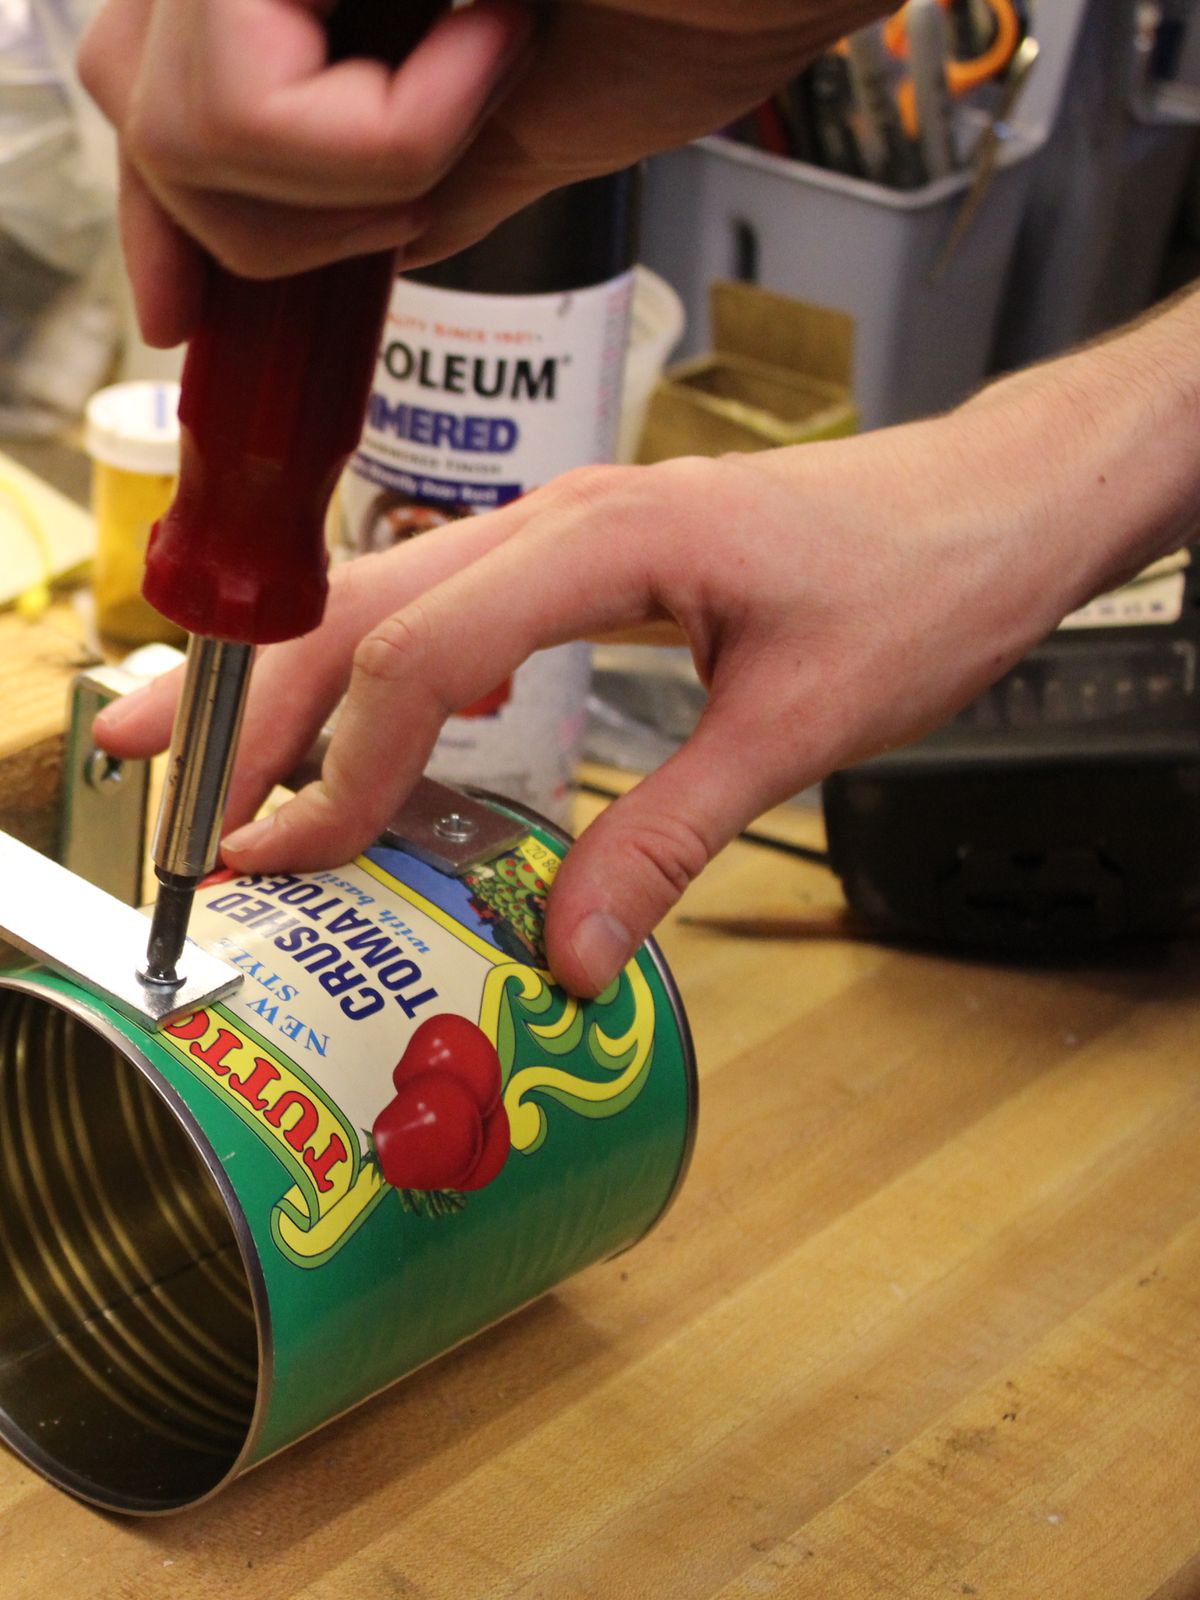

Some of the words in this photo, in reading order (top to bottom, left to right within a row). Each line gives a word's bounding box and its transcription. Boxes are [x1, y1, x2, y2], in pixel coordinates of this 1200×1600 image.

[383, 339, 558, 401] OLEUM
[367, 393, 519, 454] MERED
[312, 873, 376, 906] basil
[205, 892, 385, 1021] CRUSHED
[236, 873, 439, 1019] TOMATOES
[377, 909, 431, 954] with
[246, 997, 331, 1057] NEW
